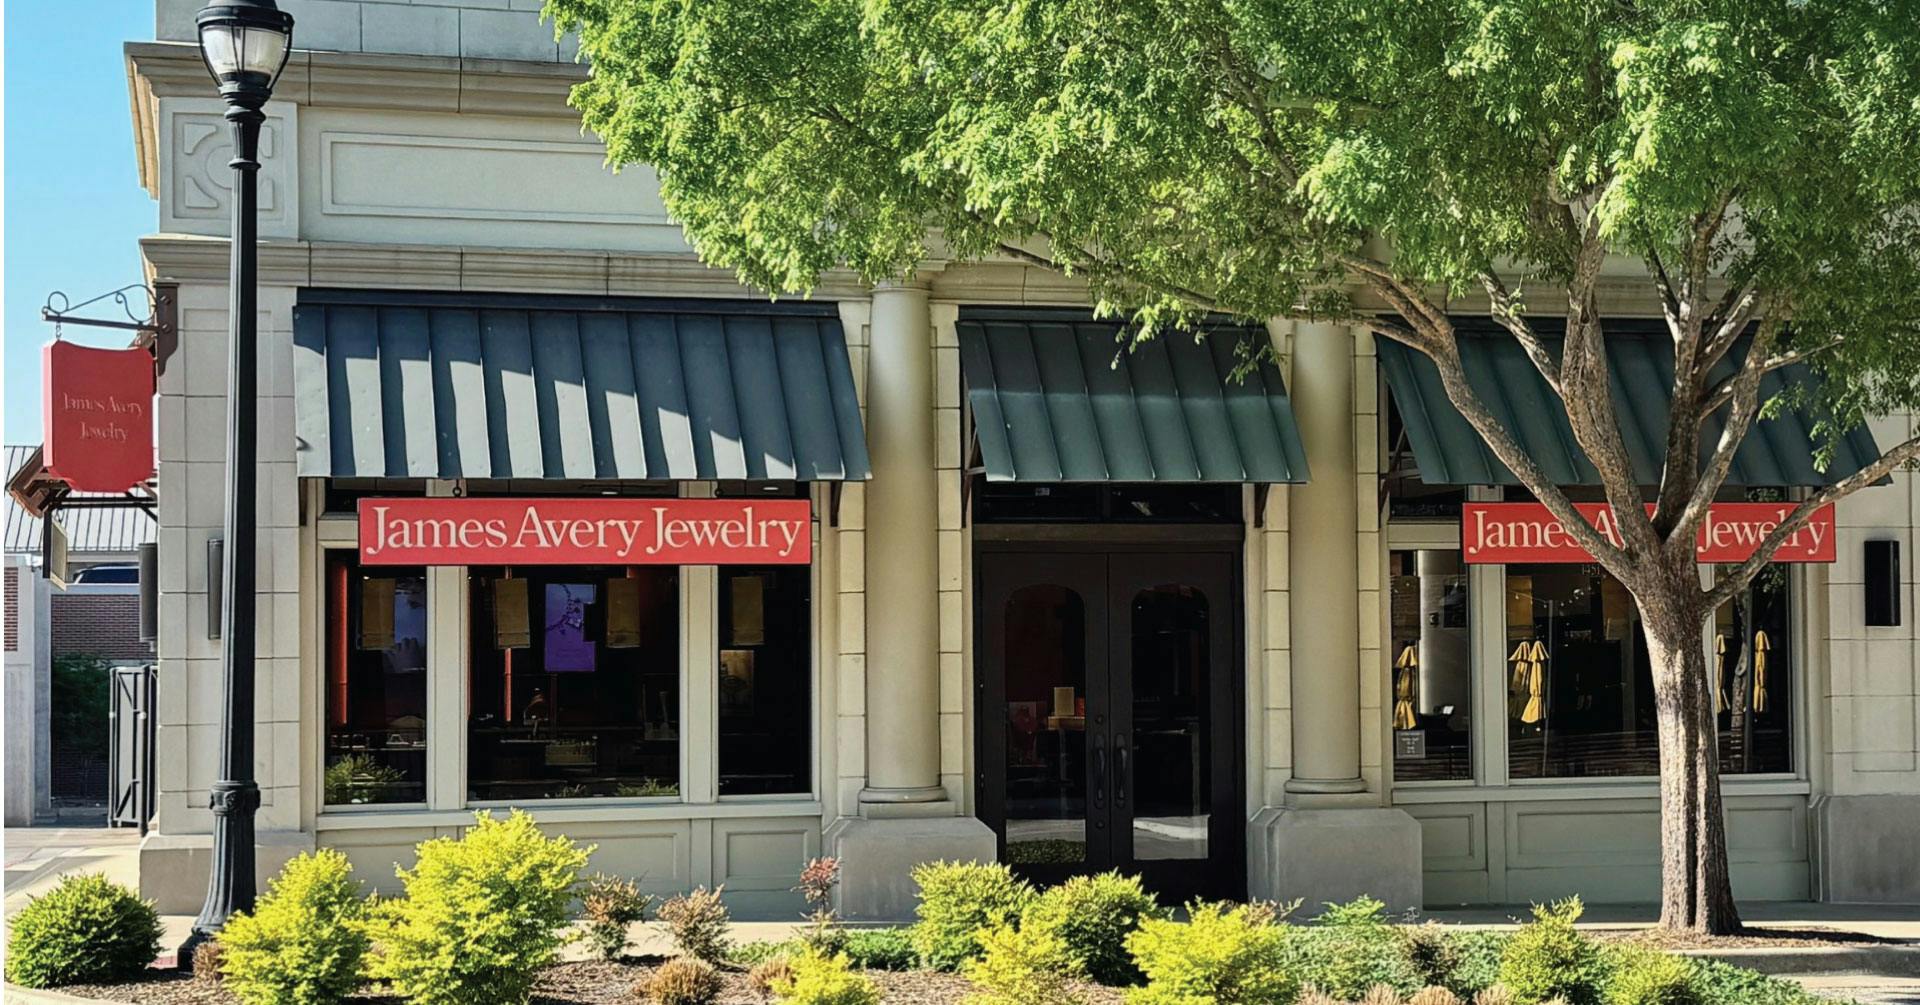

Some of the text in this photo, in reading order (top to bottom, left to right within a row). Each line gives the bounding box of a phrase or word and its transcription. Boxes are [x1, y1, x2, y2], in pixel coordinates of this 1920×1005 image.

[366, 506, 803, 557] James Avery Jewelry
